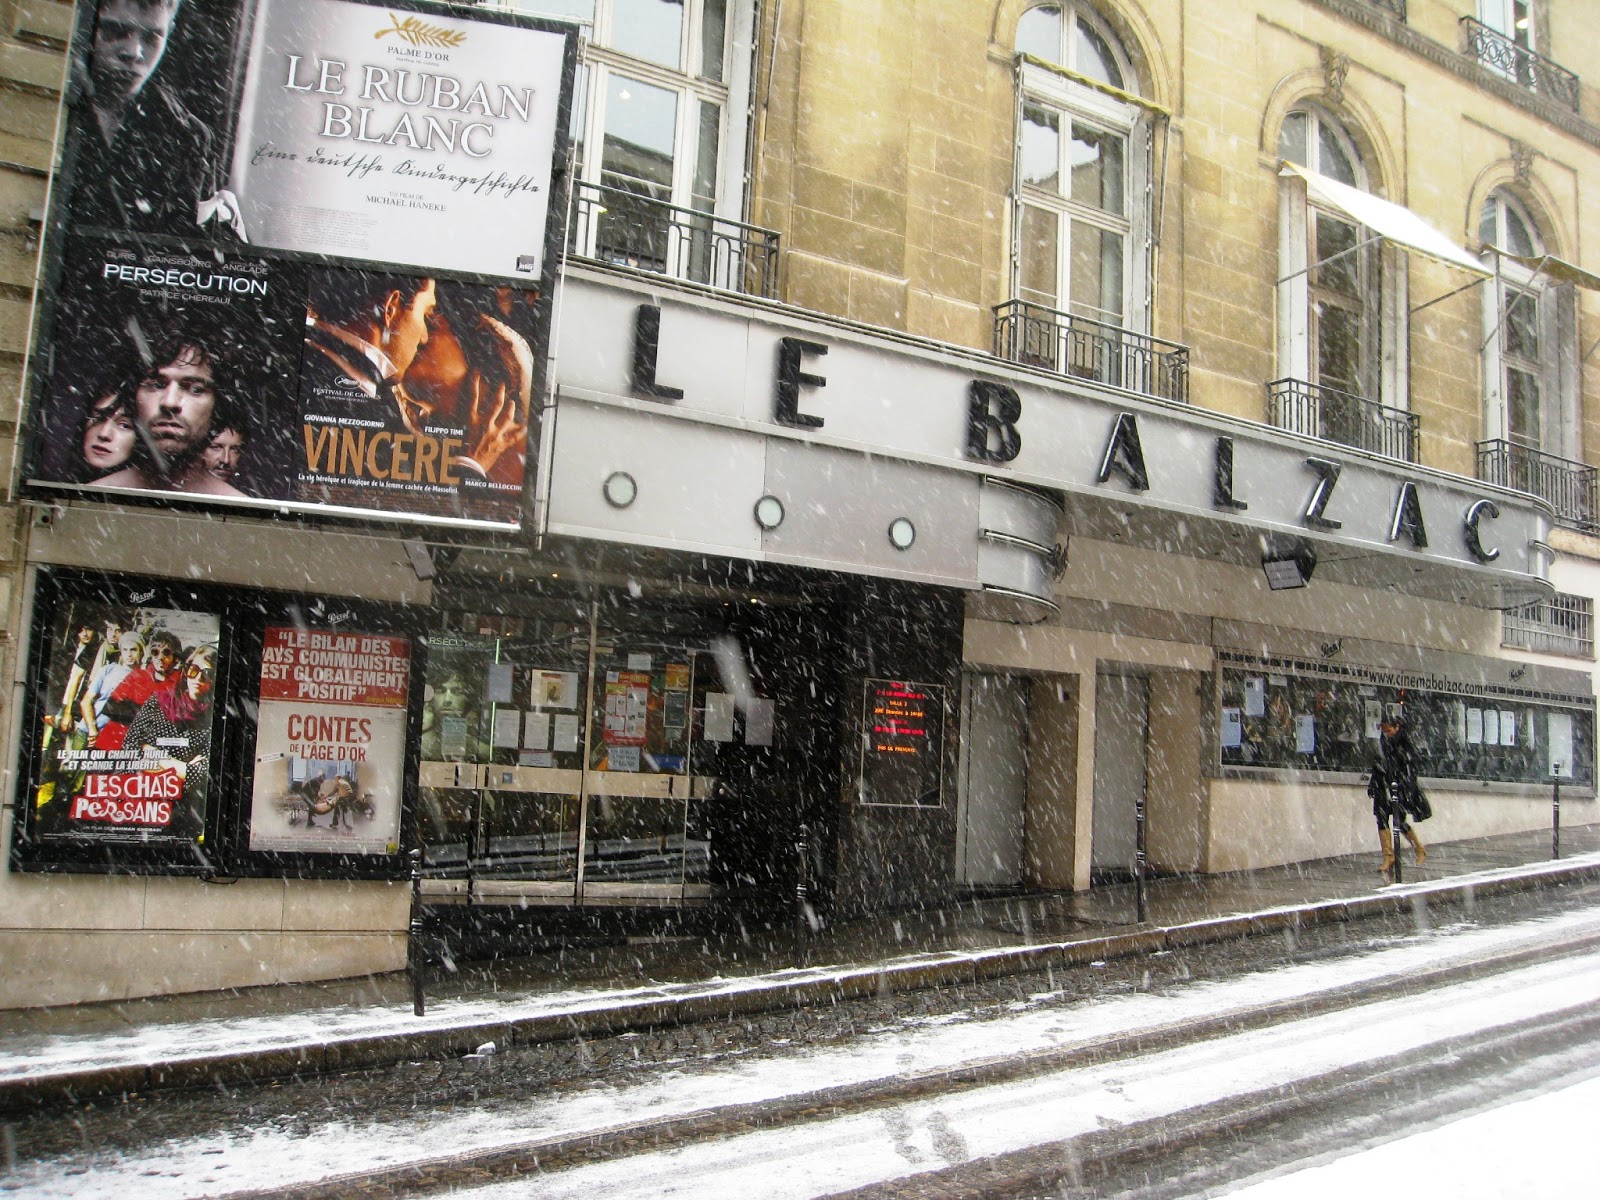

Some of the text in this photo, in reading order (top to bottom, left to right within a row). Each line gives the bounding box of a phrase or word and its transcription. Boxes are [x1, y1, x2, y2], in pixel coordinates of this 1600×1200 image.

[387, 46, 450, 62] PALME D'OR
[283, 54, 535, 122] LE RUBAN
[319, 100, 494, 158] BLANC
[366, 195, 447, 212] MICHAEL HANEKE
[222, 263, 269, 275] ANGLADE
[140, 288, 180, 300] PATRICE
[312, 387, 343, 397] FESTIVAL
[304, 414, 385, 428] GIOVANNA MEZZOGIORNO
[424, 426, 463, 436] FILIPPO TIMI
[630, 303, 1500, 562] LE BALZAC
[303, 424, 463, 485] VINCERE
[298, 472, 306, 480] La
[306, 474, 315, 482] vie
[348, 478, 370, 487] tragique
[385, 480, 405, 489] femme
[424, 484, 432, 492] de
[464, 480, 487, 488] MARCO
[129, 588, 156, 604] Persol
[311, 634, 357, 652] BILAN
[361, 638, 391, 655] DES
[262, 647, 411, 673] AYS COMMUNISTES
[261, 664, 406, 689] EST GLOBALEMENT
[1369, 670, 1484, 695] www.cinemabalzac.com
[287, 714, 371, 744] CONTES
[57, 749, 68, 760] LE
[69, 750, 89, 760] FILM
[90, 750, 106, 760] QUI
[289, 742, 366, 762] DE L'ÂGE D'OR
[68, 761, 80, 771] ET
[80, 761, 114, 771] SCANDE
[115, 761, 125, 771] LA
[85, 770, 180, 798] LES CHATS
